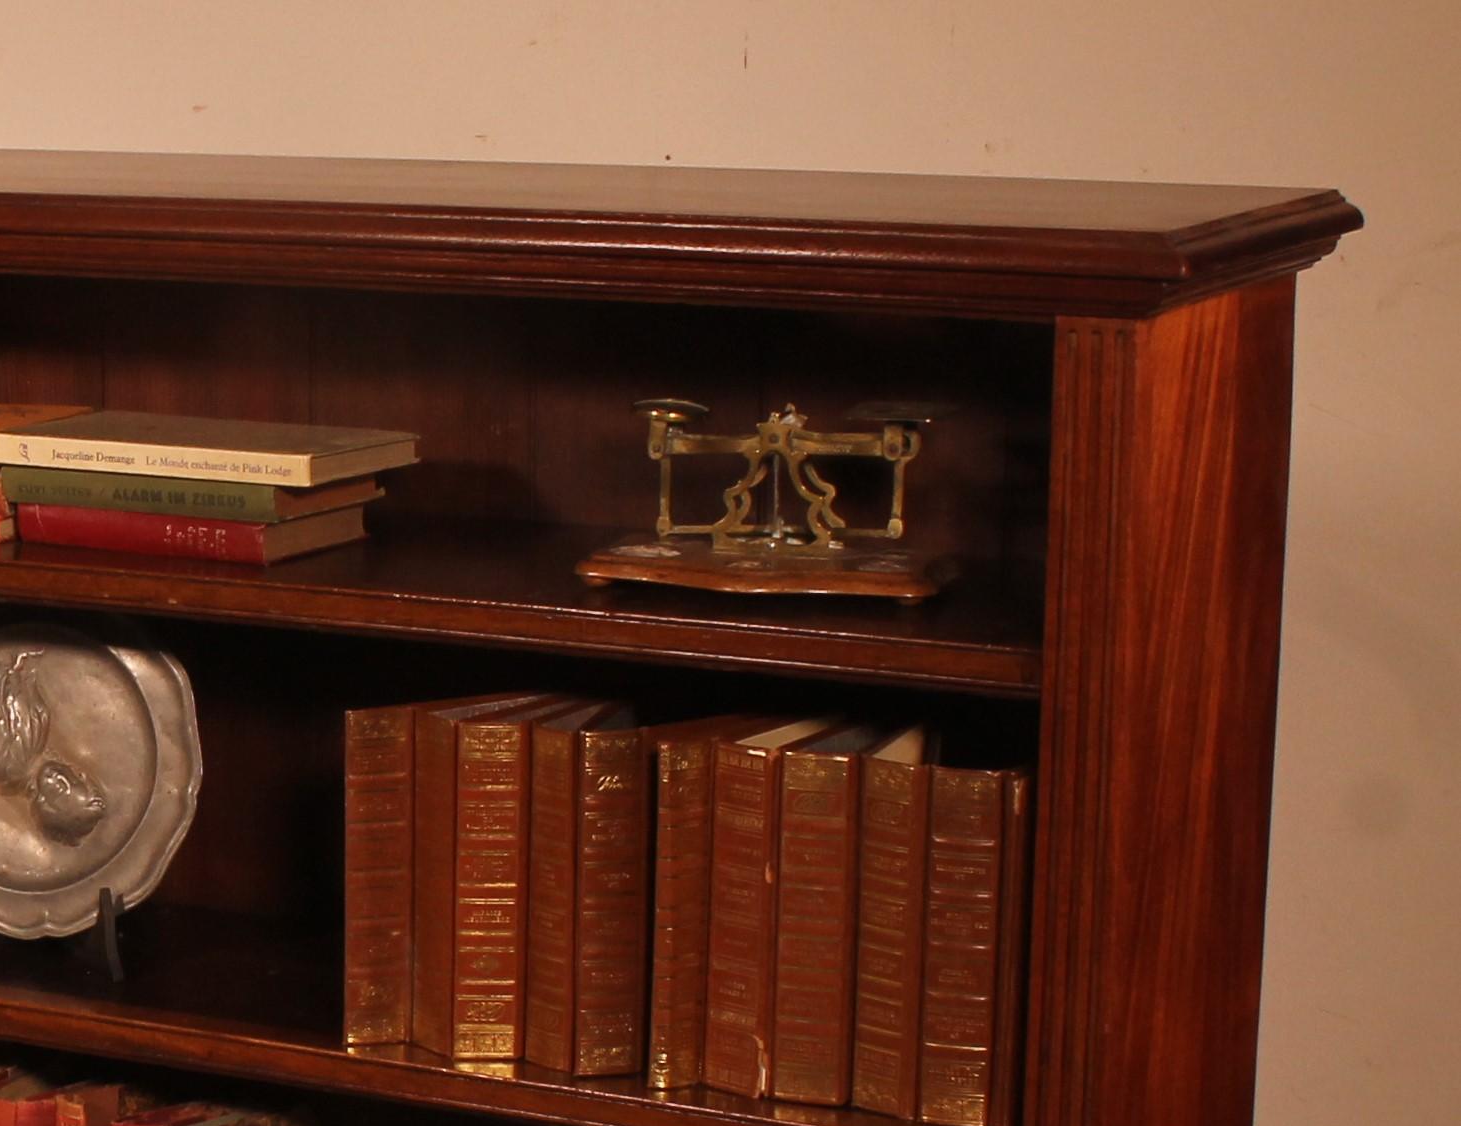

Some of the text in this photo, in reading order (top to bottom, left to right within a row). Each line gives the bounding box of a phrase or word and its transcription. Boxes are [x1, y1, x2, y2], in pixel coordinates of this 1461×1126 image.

[52, 448, 136, 465] Jacqueline Demange
[145, 455, 158, 465] Le
[229, 462, 241, 473] de
[242, 463, 263, 475] Pink
